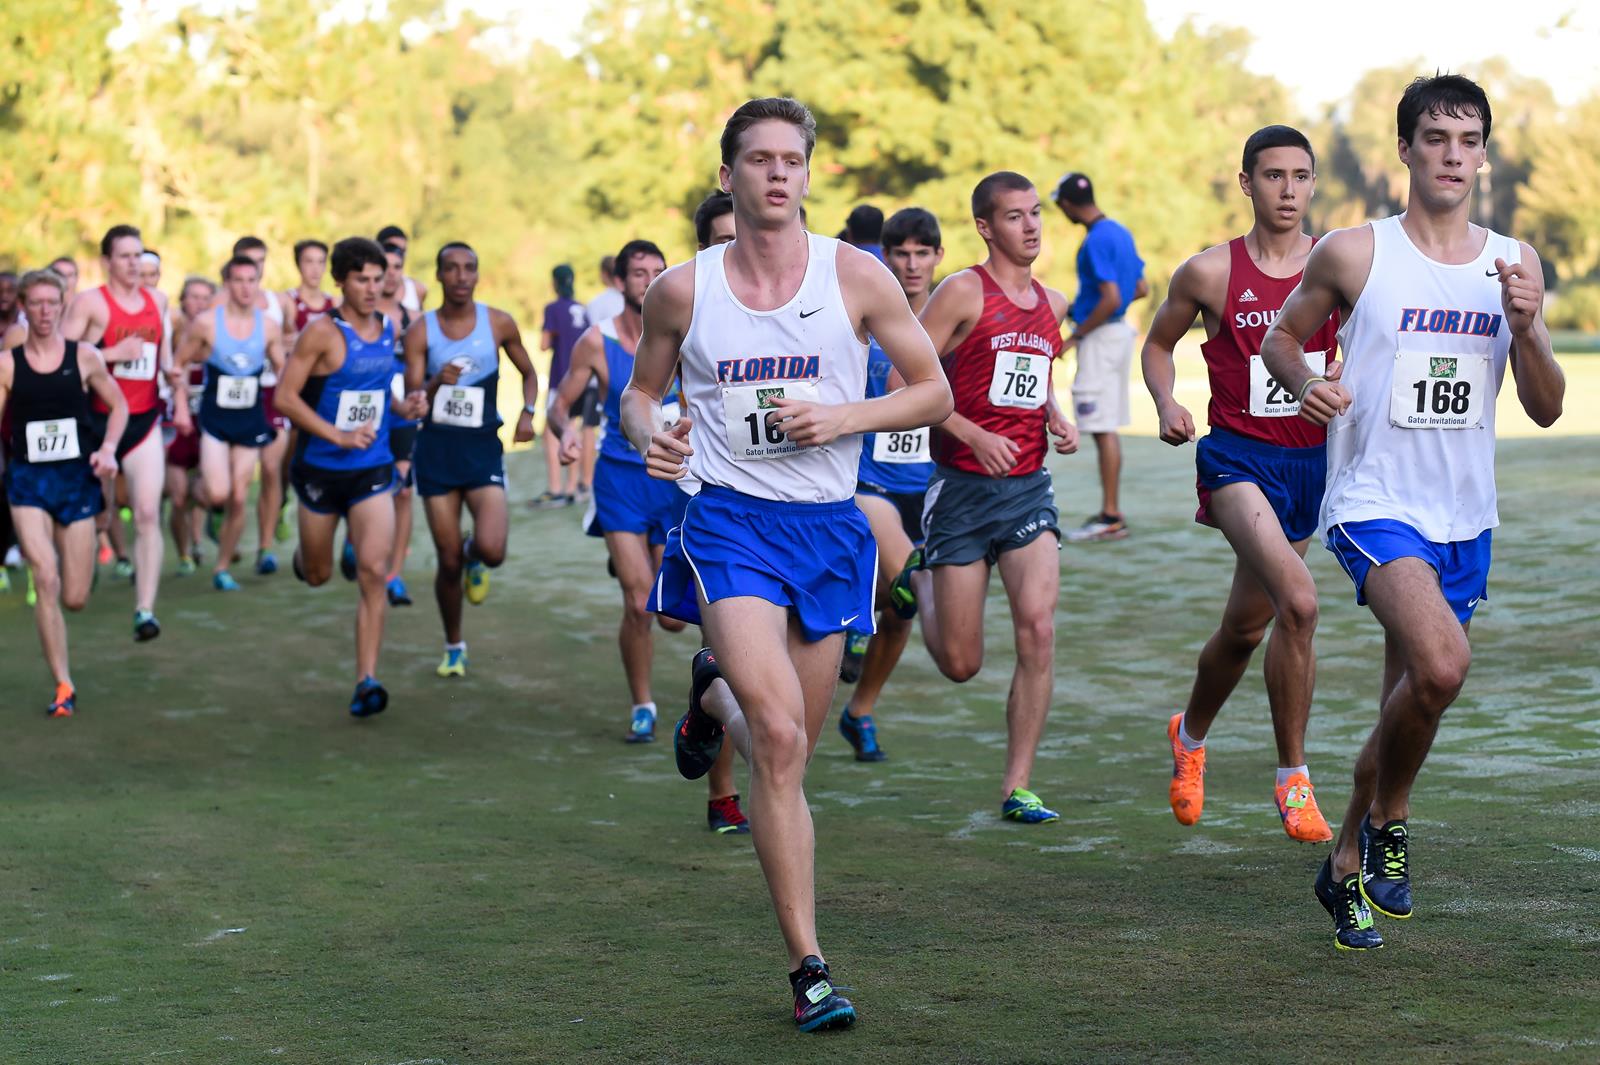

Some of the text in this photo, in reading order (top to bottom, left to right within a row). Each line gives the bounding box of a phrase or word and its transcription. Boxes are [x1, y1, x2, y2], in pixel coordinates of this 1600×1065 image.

[1398, 308, 1502, 338] FLORIDA
[991, 332, 1053, 358] WEST ALABAMA
[716, 355, 820, 383] FLORIDA
[1003, 371, 1038, 399] 762
[1413, 380, 1471, 415] 168
[744, 411, 785, 446] 16
[1408, 415, 1467, 425] Gator Invitational
[38, 434, 67, 451] 677
[745, 448, 765, 456] Gator
[888, 432, 922, 453] 361
